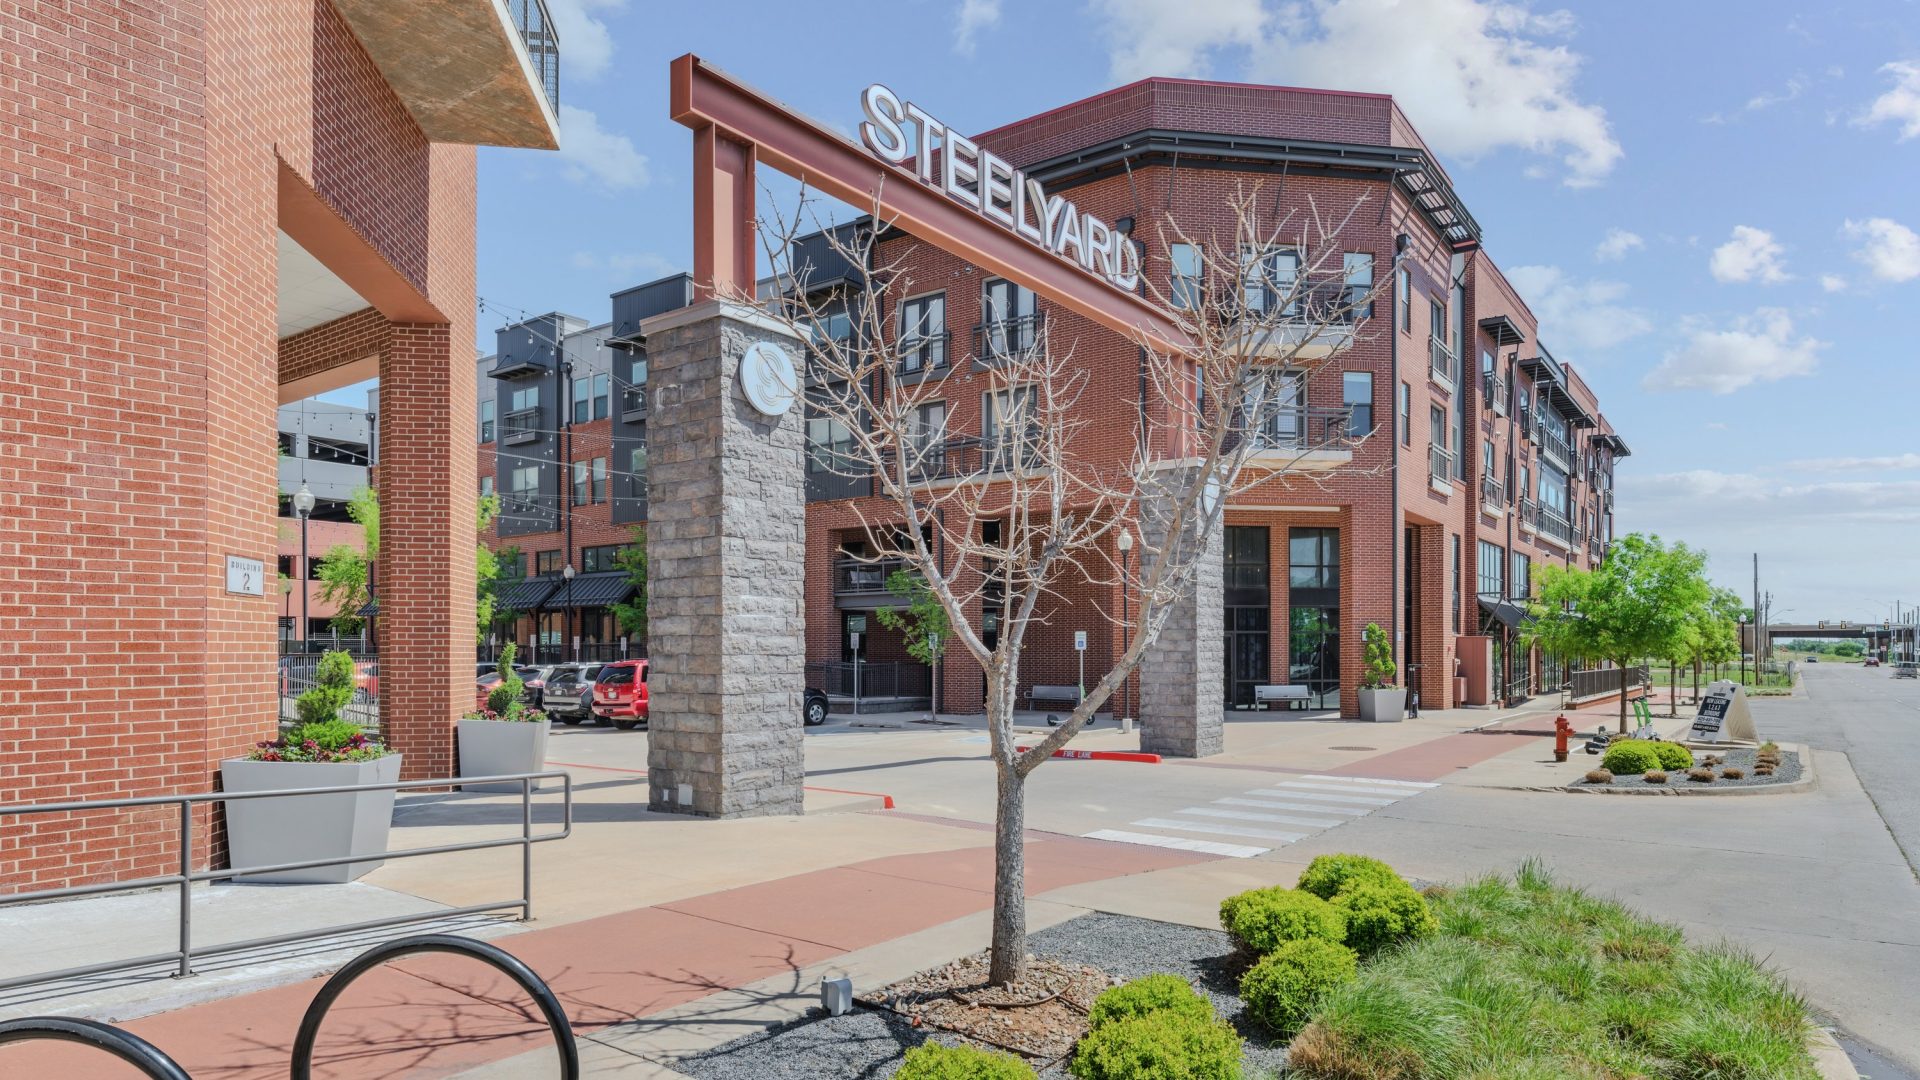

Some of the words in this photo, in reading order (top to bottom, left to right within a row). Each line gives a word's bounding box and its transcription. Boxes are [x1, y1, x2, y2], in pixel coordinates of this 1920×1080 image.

[858, 83, 1139, 291] STEELYARD
[231, 561, 261, 572] BUILDING
[243, 572, 250, 591] 2
